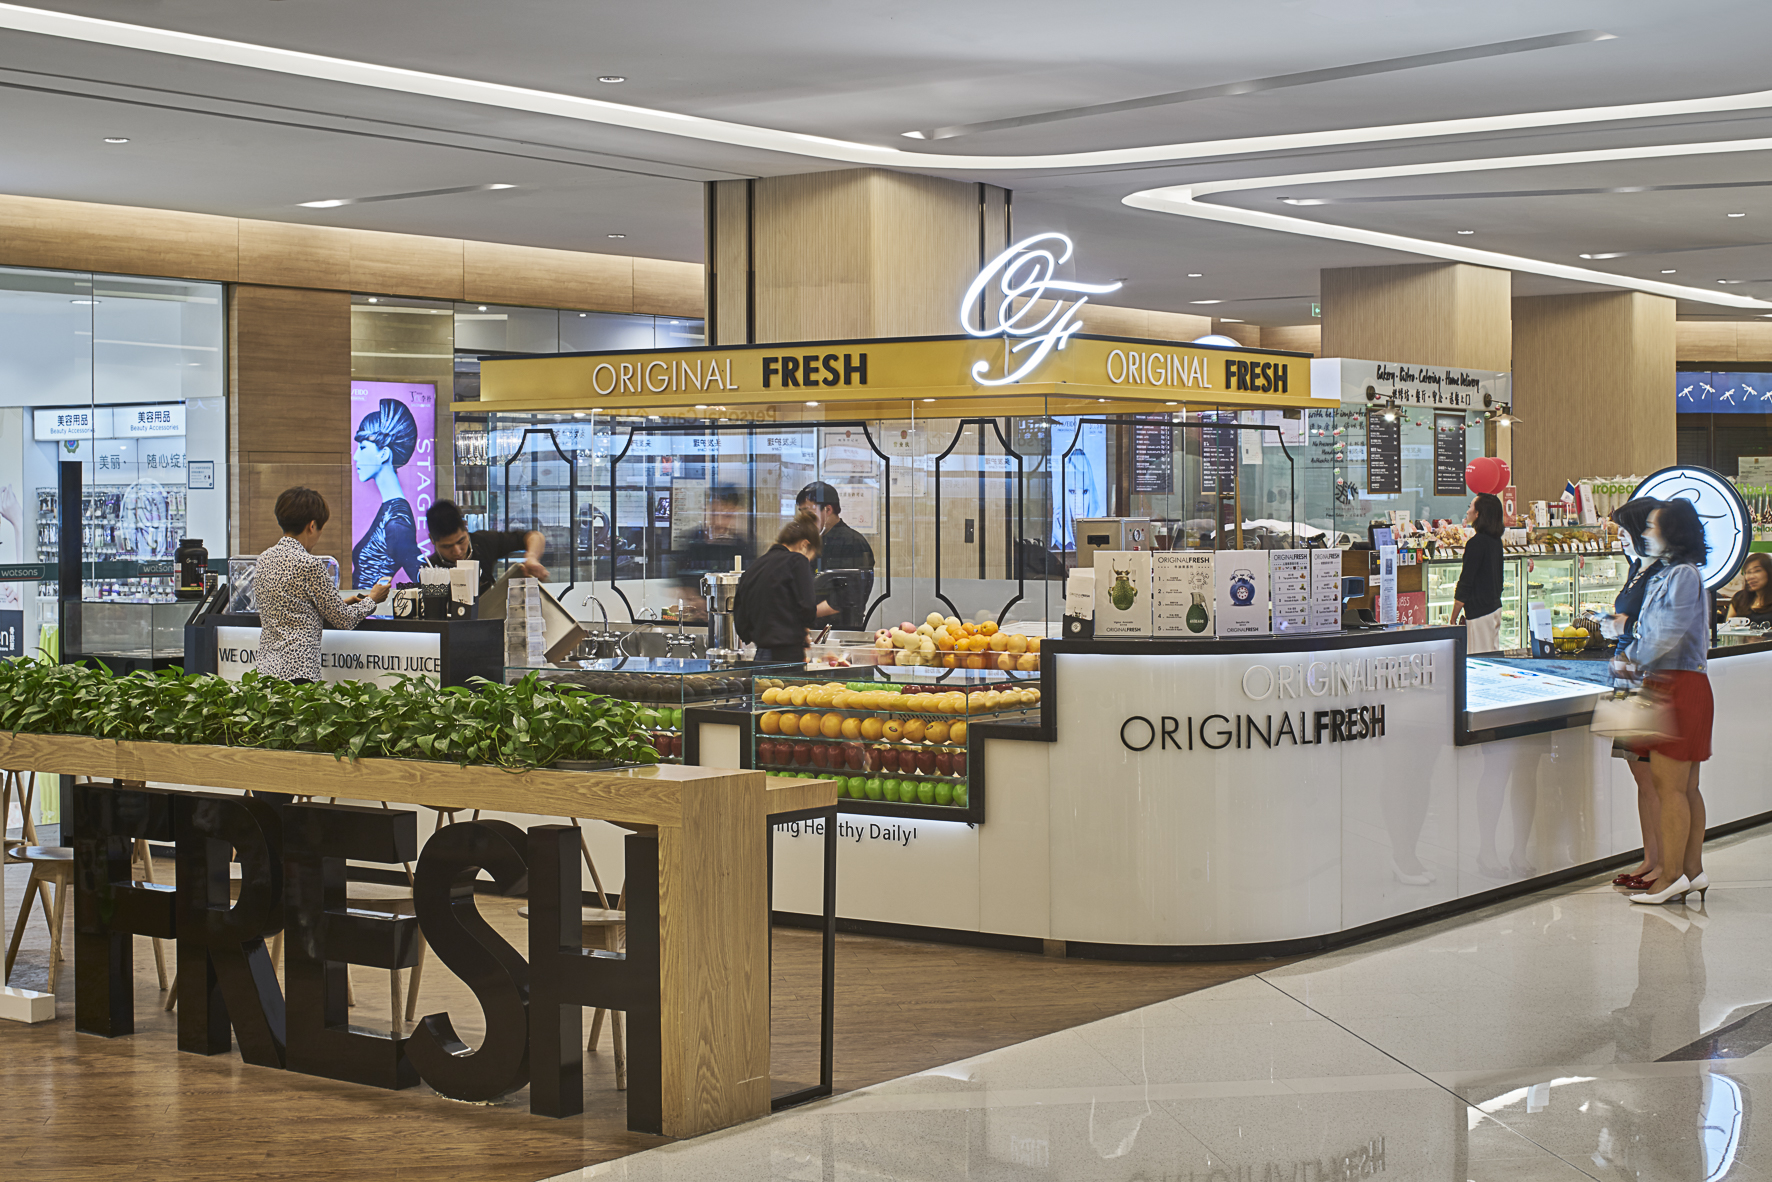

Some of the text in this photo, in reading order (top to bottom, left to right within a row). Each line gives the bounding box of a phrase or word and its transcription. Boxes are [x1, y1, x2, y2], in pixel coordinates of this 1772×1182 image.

[592, 353, 869, 396] ORIGINAL FRESH
[1106, 349, 1289, 394] ORIGINAL FRESH
[57, 414, 89, 427] 美容用品
[130, 423, 179, 432] Beauty Accessories
[137, 410, 171, 424] 美容用品
[50, 426, 96, 435] Beauty Accessoris
[416, 438, 432, 531] STAGE
[1746, 482, 1763, 495] be
[1, 567, 39, 577] watsons
[1157, 556, 1210, 564] ORIGINALFRESH
[218, 648, 238, 663] WE
[239, 649, 257, 664] ON
[331, 652, 364, 670] 100%
[366, 654, 401, 671] FRUIT
[403, 656, 441, 673] JUICE
[1241, 652, 1437, 701] ORIGINALFRESH
[1119, 703, 1386, 752] ORIGINALFRESH
[804, 818, 865, 843] Hethy
[869, 823, 918, 847] Daily!
[73, 782, 664, 1136] FRESH
